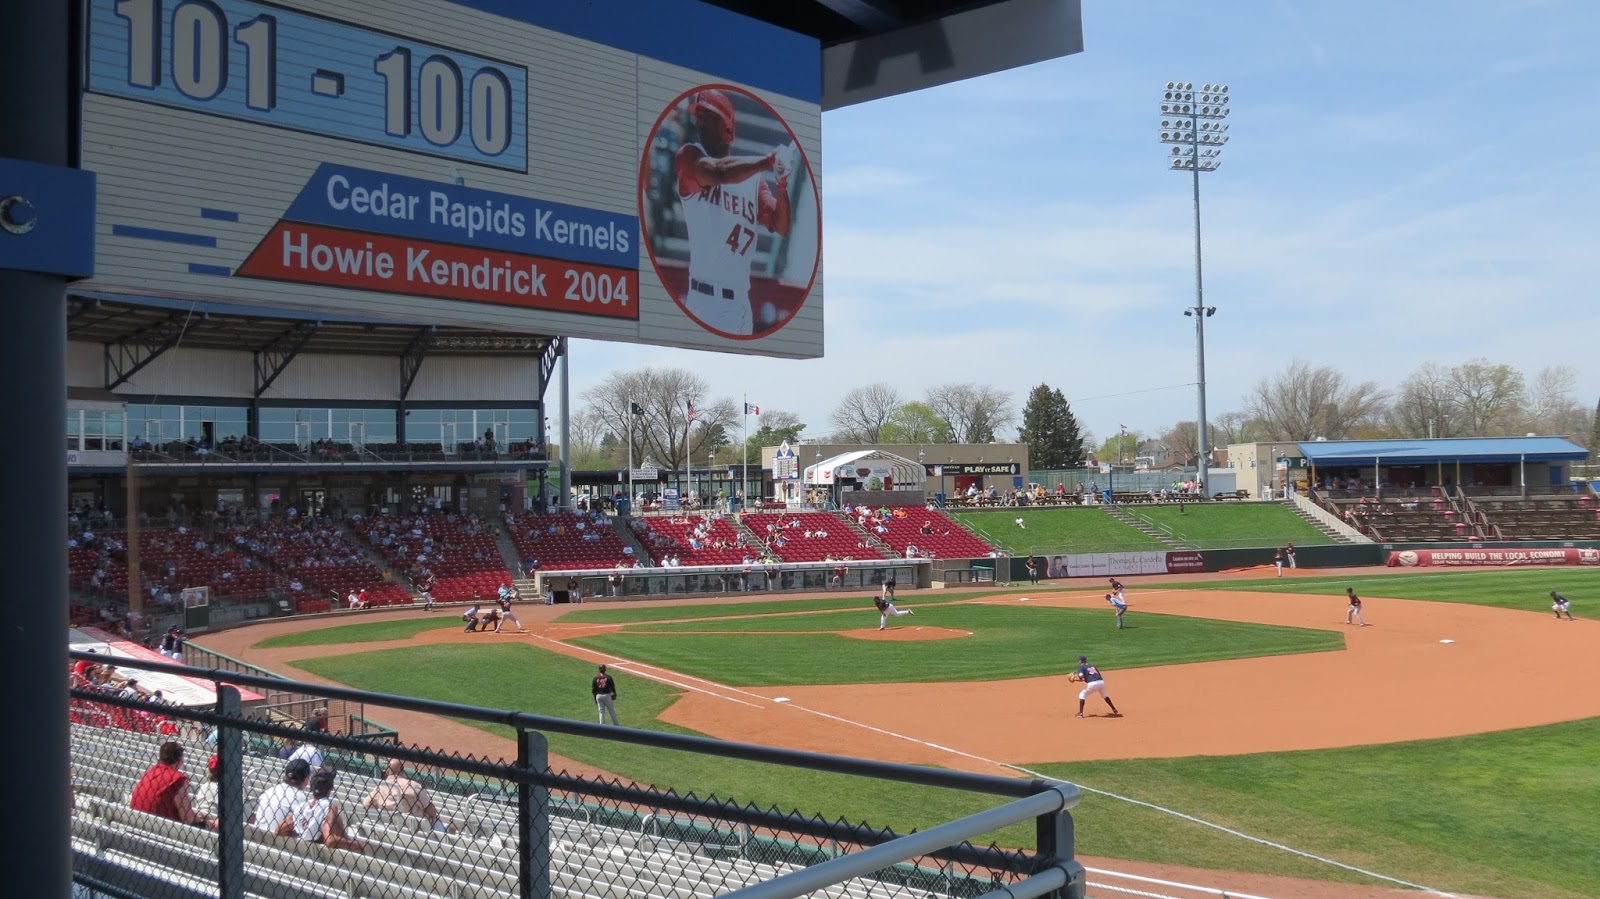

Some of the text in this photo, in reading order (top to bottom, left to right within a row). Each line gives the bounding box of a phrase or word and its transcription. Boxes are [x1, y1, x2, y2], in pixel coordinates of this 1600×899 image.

[114, 0, 277, 112] 101
[374, 46, 512, 157] 100
[327, 174, 630, 253] Cedar Rapids Kernels
[698, 184, 755, 225] ANGELS
[726, 223, 755, 257] 47
[283, 230, 629, 307] Howie Kendrick 2004
[991, 465, 1009, 473] SAFE
[1109, 557, 1131, 565] Thomas
[1139, 555, 1163, 564] Cardella
[1431, 550, 1566, 560] HELPING BUILD THE LOCAL ECONOMY
